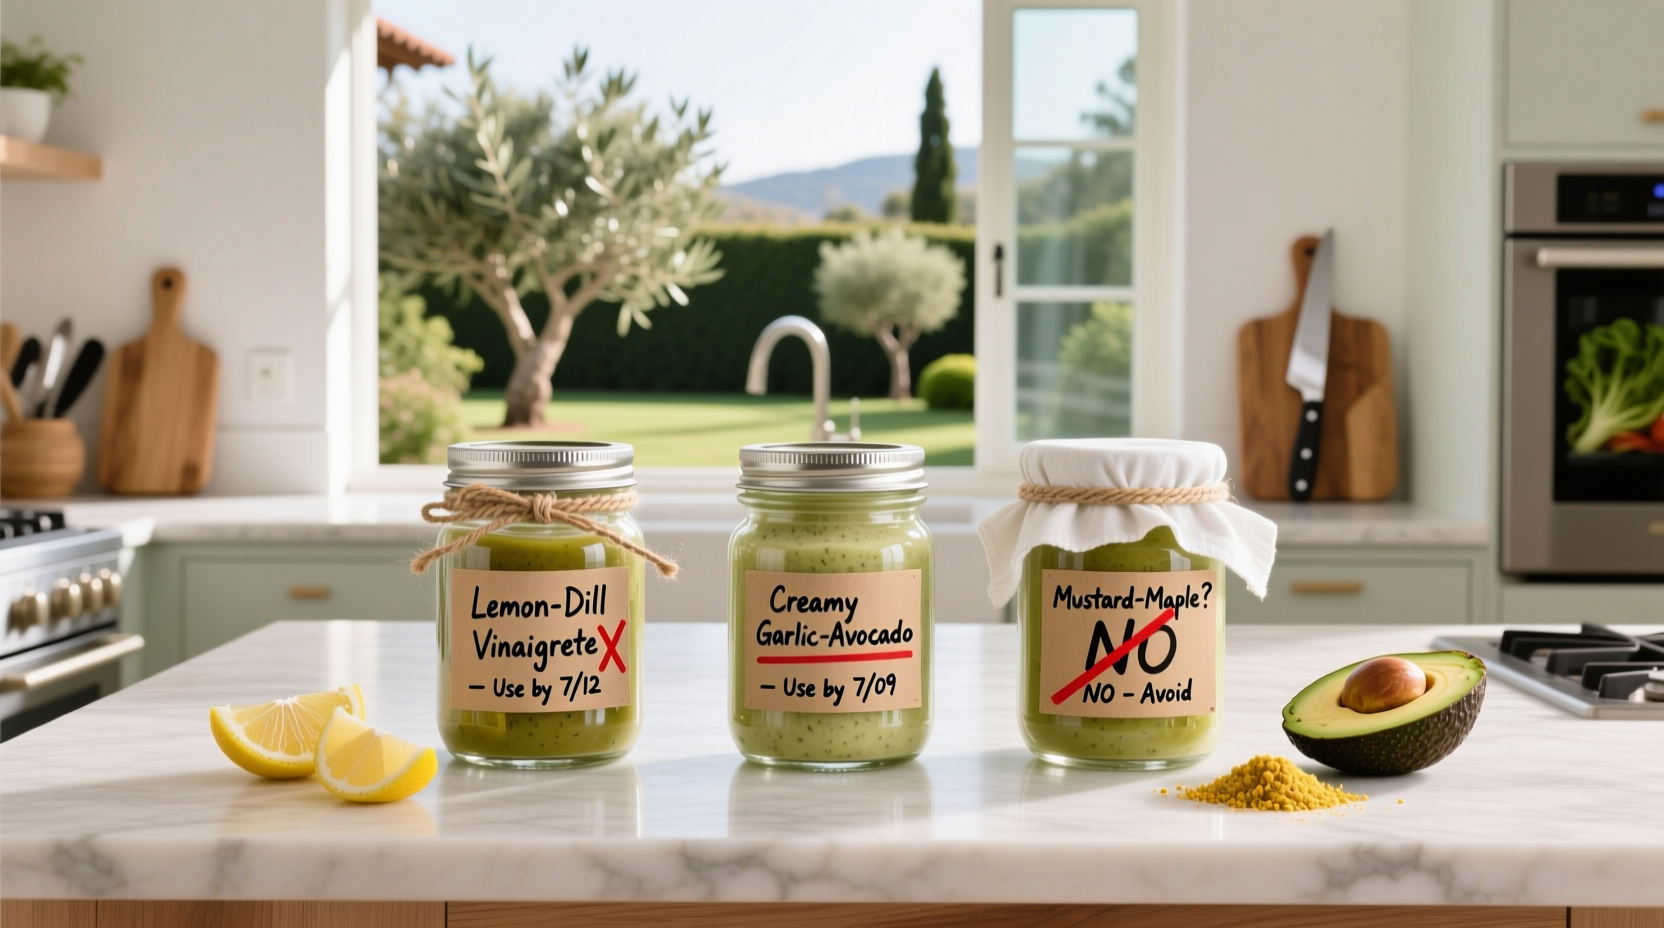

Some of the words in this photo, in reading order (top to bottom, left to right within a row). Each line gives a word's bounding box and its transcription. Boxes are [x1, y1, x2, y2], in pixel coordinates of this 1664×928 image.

[471, 584, 606, 619] Lemon-Dill
[770, 585, 858, 624] Creamy
[1053, 581, 1213, 620] Mustard-Maple?
[473, 628, 598, 672] Vinaigrete
[757, 619, 913, 648] Garlic-Avocado
[1085, 618, 1177, 676] NO
[493, 678, 525, 698] Use
[531, 678, 552, 706] by
[559, 671, 602, 702] 7/12
[783, 677, 816, 697] Use
[823, 678, 845, 707] by
[852, 672, 897, 703] 7/09
[1082, 682, 1115, 704] NO
[1140, 678, 1193, 704] Avoid
